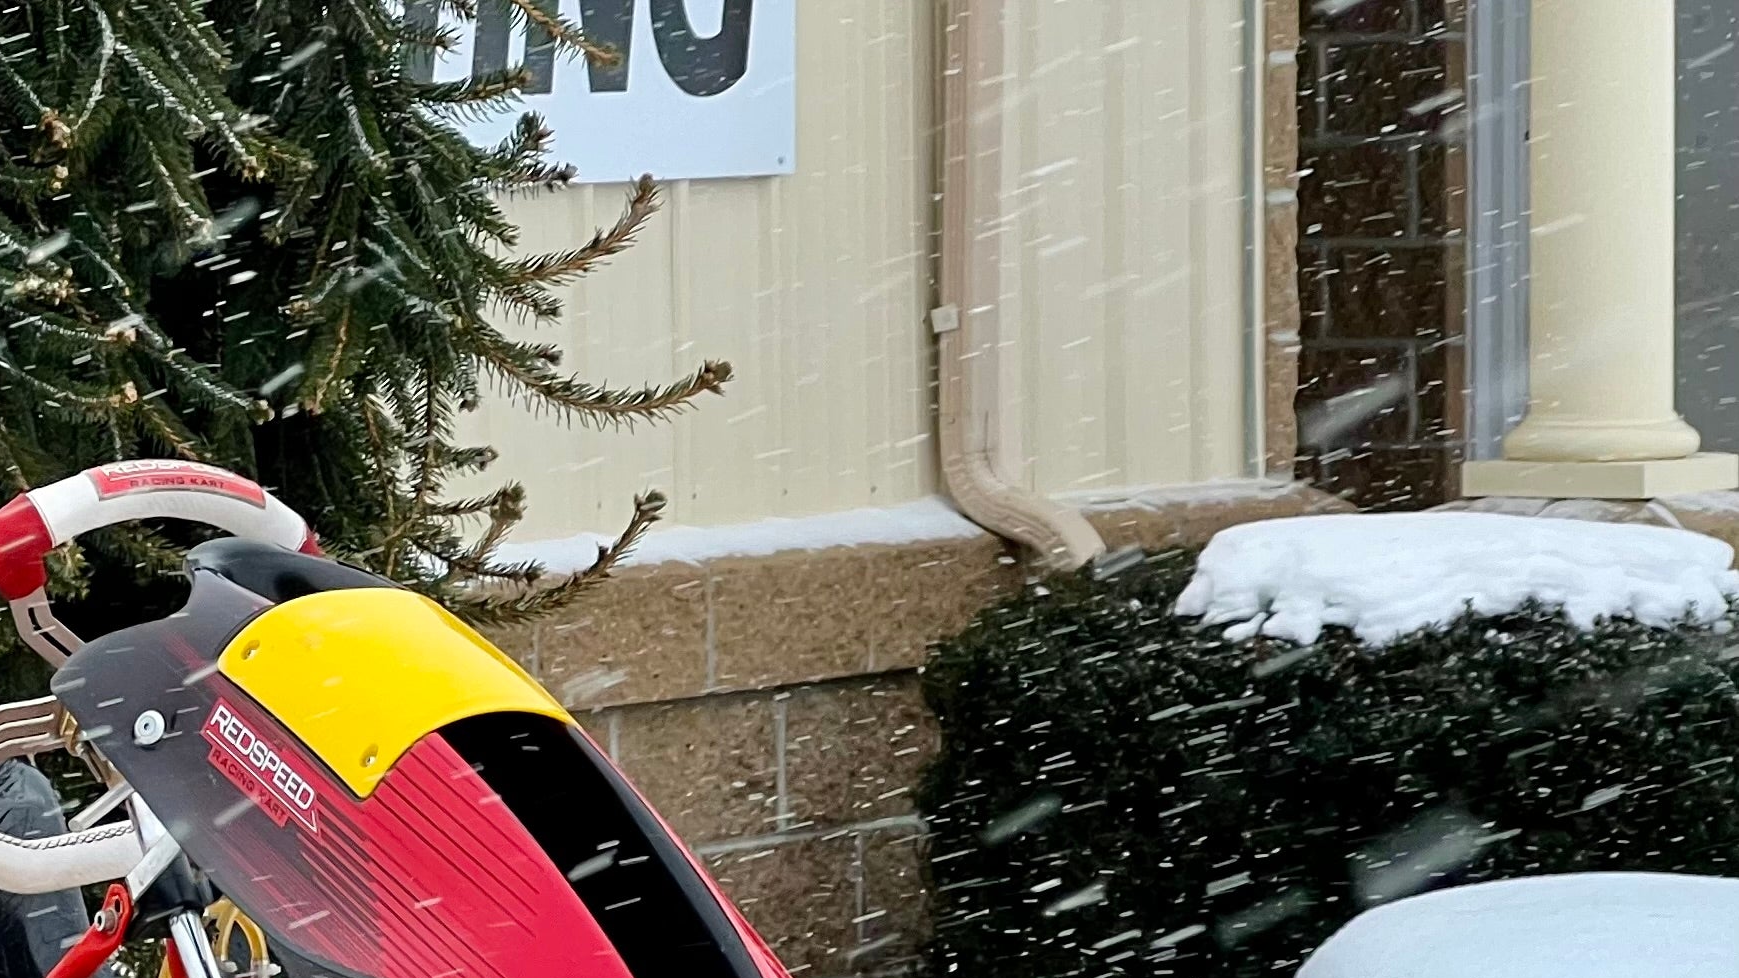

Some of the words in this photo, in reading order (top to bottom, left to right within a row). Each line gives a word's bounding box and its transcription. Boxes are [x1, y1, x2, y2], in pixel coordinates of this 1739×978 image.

[129, 476, 185, 488] RACING
[189, 477, 225, 489] KART
[210, 704, 315, 810] REDSPEED
[212, 750, 255, 792] RACING
[258, 790, 287, 820] KART
